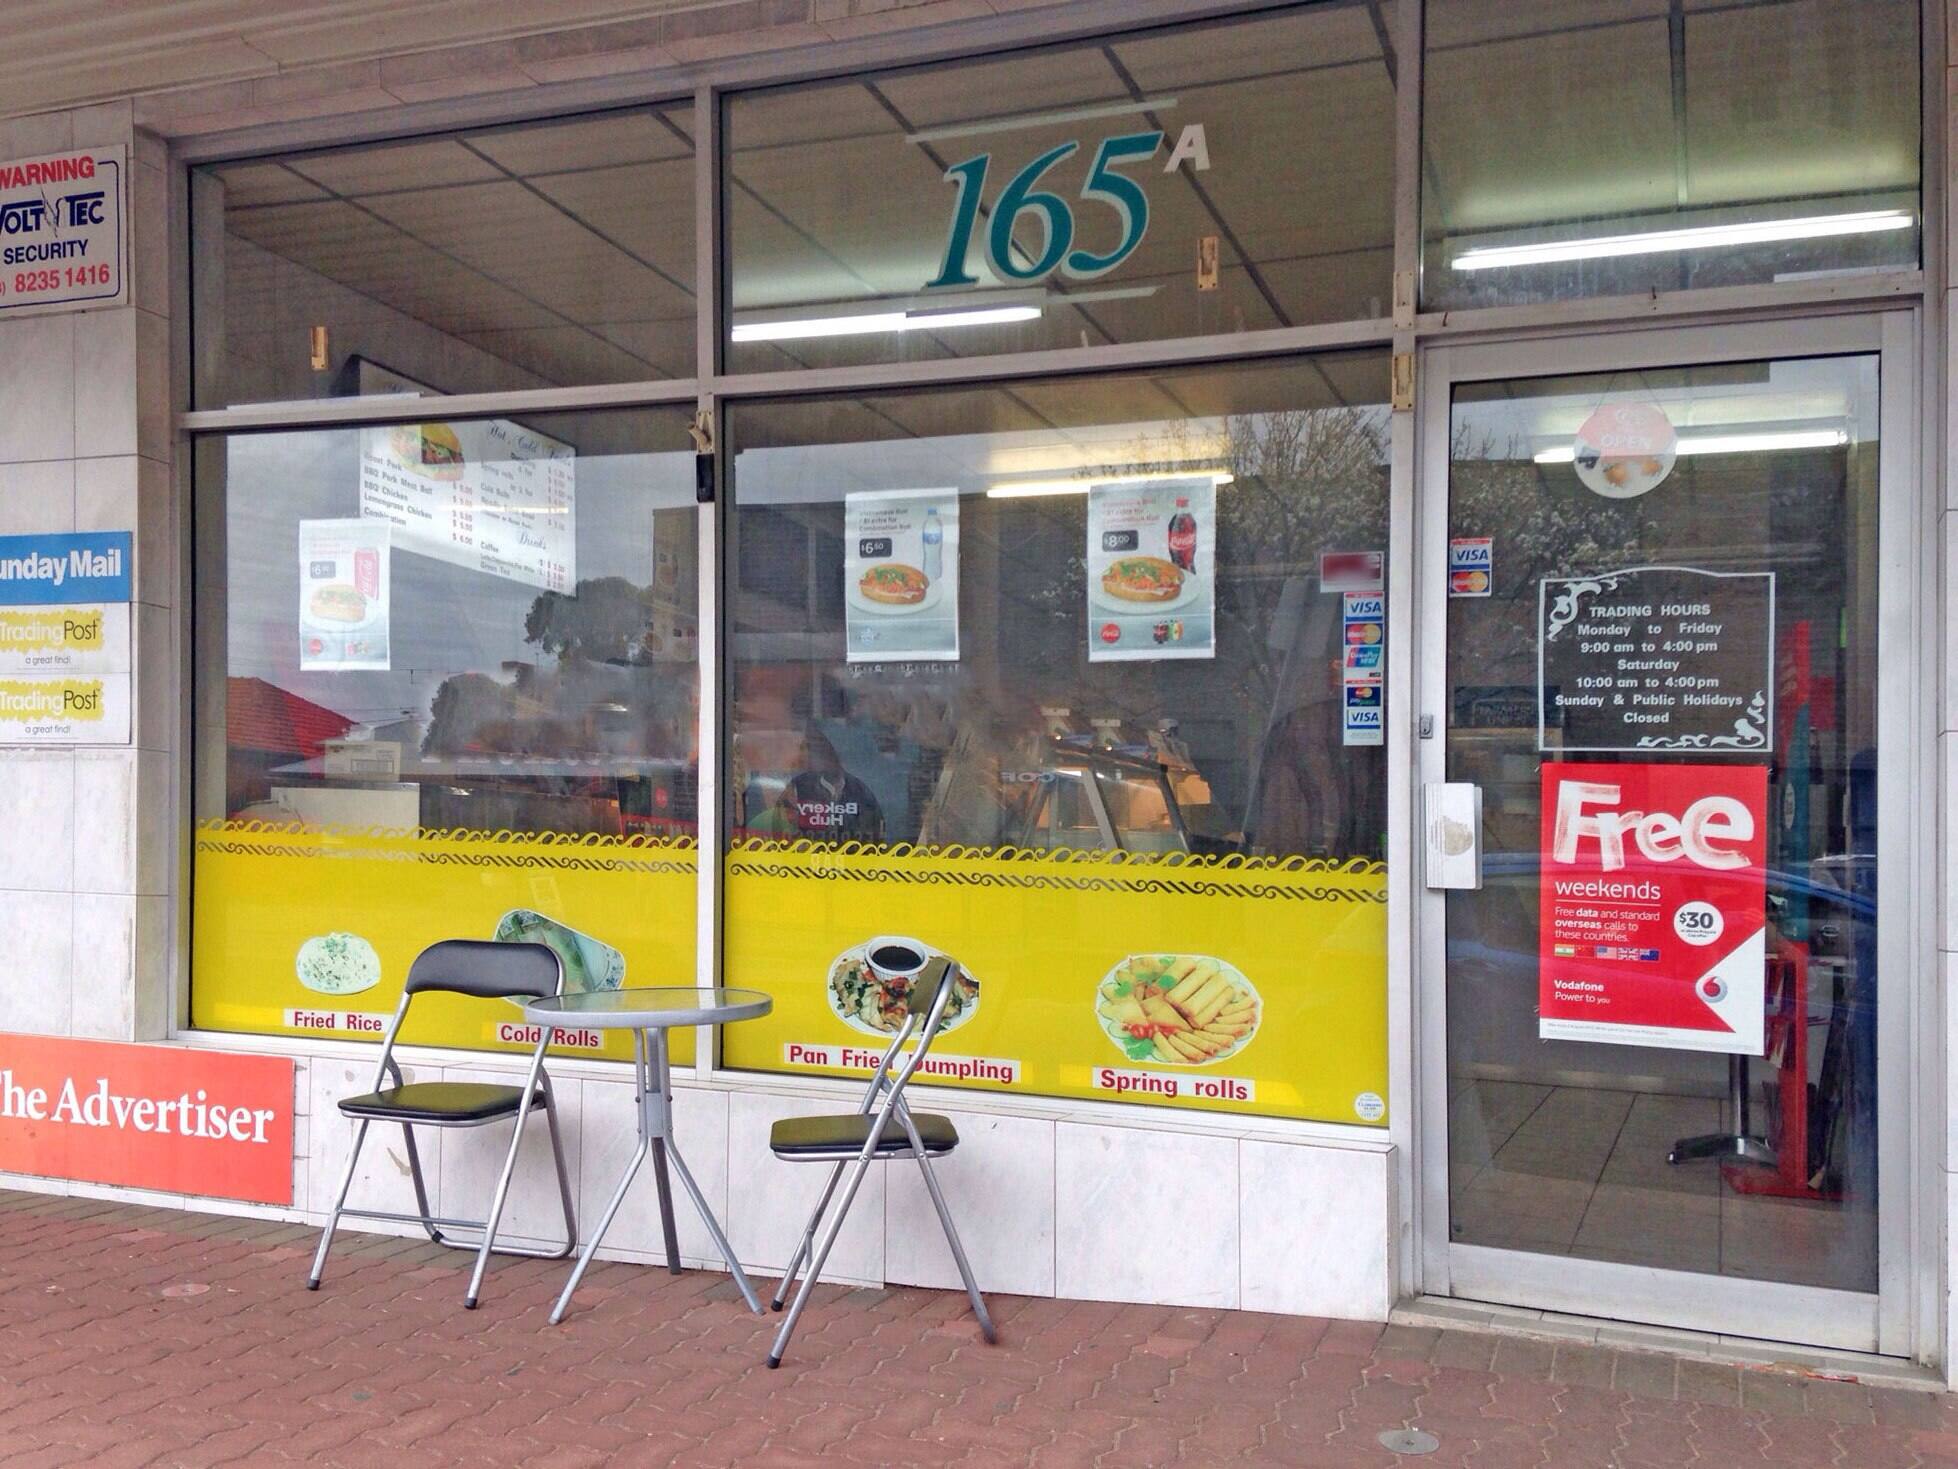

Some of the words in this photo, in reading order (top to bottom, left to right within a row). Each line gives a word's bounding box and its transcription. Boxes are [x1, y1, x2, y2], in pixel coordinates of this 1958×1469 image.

[0, 156, 95, 190] WARNING
[64, 191, 105, 227] TEC
[920, 131, 1165, 289] 165
[1163, 123, 1210, 173] A
[3, 239, 89, 266] SECURITY
[15, 269, 60, 293] 8235
[65, 263, 110, 287] 1416
[1456, 549, 1488, 561] VISA
[70, 549, 121, 578] Mail
[1351, 602, 1382, 613] VISA
[1589, 604, 1652, 618] TRADING
[1660, 604, 1711, 616] HOURS
[1577, 623, 1631, 637] Monday
[1648, 624, 1661, 635] to
[1679, 622, 1722, 636] Friday
[1580, 642, 1610, 653] 9:00
[1613, 643, 1634, 652] am
[1641, 641, 1655, 652] to
[1662, 640, 1693, 652] 4:00
[1696, 642, 1718, 654] pm
[32, 655, 53, 667] great
[1617, 659, 1680, 671] Saturday
[1576, 677, 1612, 688] 10:00
[1617, 678, 1638, 688] am
[1645, 677, 1659, 688] to
[1665, 676, 1695, 688] 4:00
[1697, 678, 1719, 690] pm
[1555, 694, 1604, 707] Sunday
[1613, 694, 1624, 706] &
[1633, 694, 1675, 706] Public
[1683, 694, 1743, 707] Holidays
[1352, 711, 1379, 722] VISA
[1623, 712, 1669, 723] Closed
[32, 725, 53, 736] great
[1553, 780, 1754, 872] Free
[1554, 879, 1661, 900] weekends
[1555, 907, 1574, 917] Free
[1576, 908, 1598, 918] data
[1600, 910, 1618, 920] and
[1619, 911, 1661, 922] standard
[1679, 911, 1714, 930] $30
[1555, 919, 1601, 930] overseas
[1604, 921, 1626, 931] calls
[1628, 922, 1639, 932] to
[1555, 930, 1582, 941] these
[1554, 980, 1604, 992] Vodafone
[1555, 992, 1584, 1002] Power
[1586, 992, 1596, 1003] to
[1597, 997, 1611, 1005] you
[294, 1012, 336, 1029] Fried
[346, 1014, 382, 1032] Rice
[500, 1024, 541, 1043] Cold
[554, 1028, 599, 1048] Rolls
[789, 1045, 828, 1065] Pan
[1101, 1069, 1178, 1098] Spring
[1195, 1080, 1248, 1100] rolls
[0, 1070, 47, 1120] he
[51, 1077, 275, 1143] Advertiser
